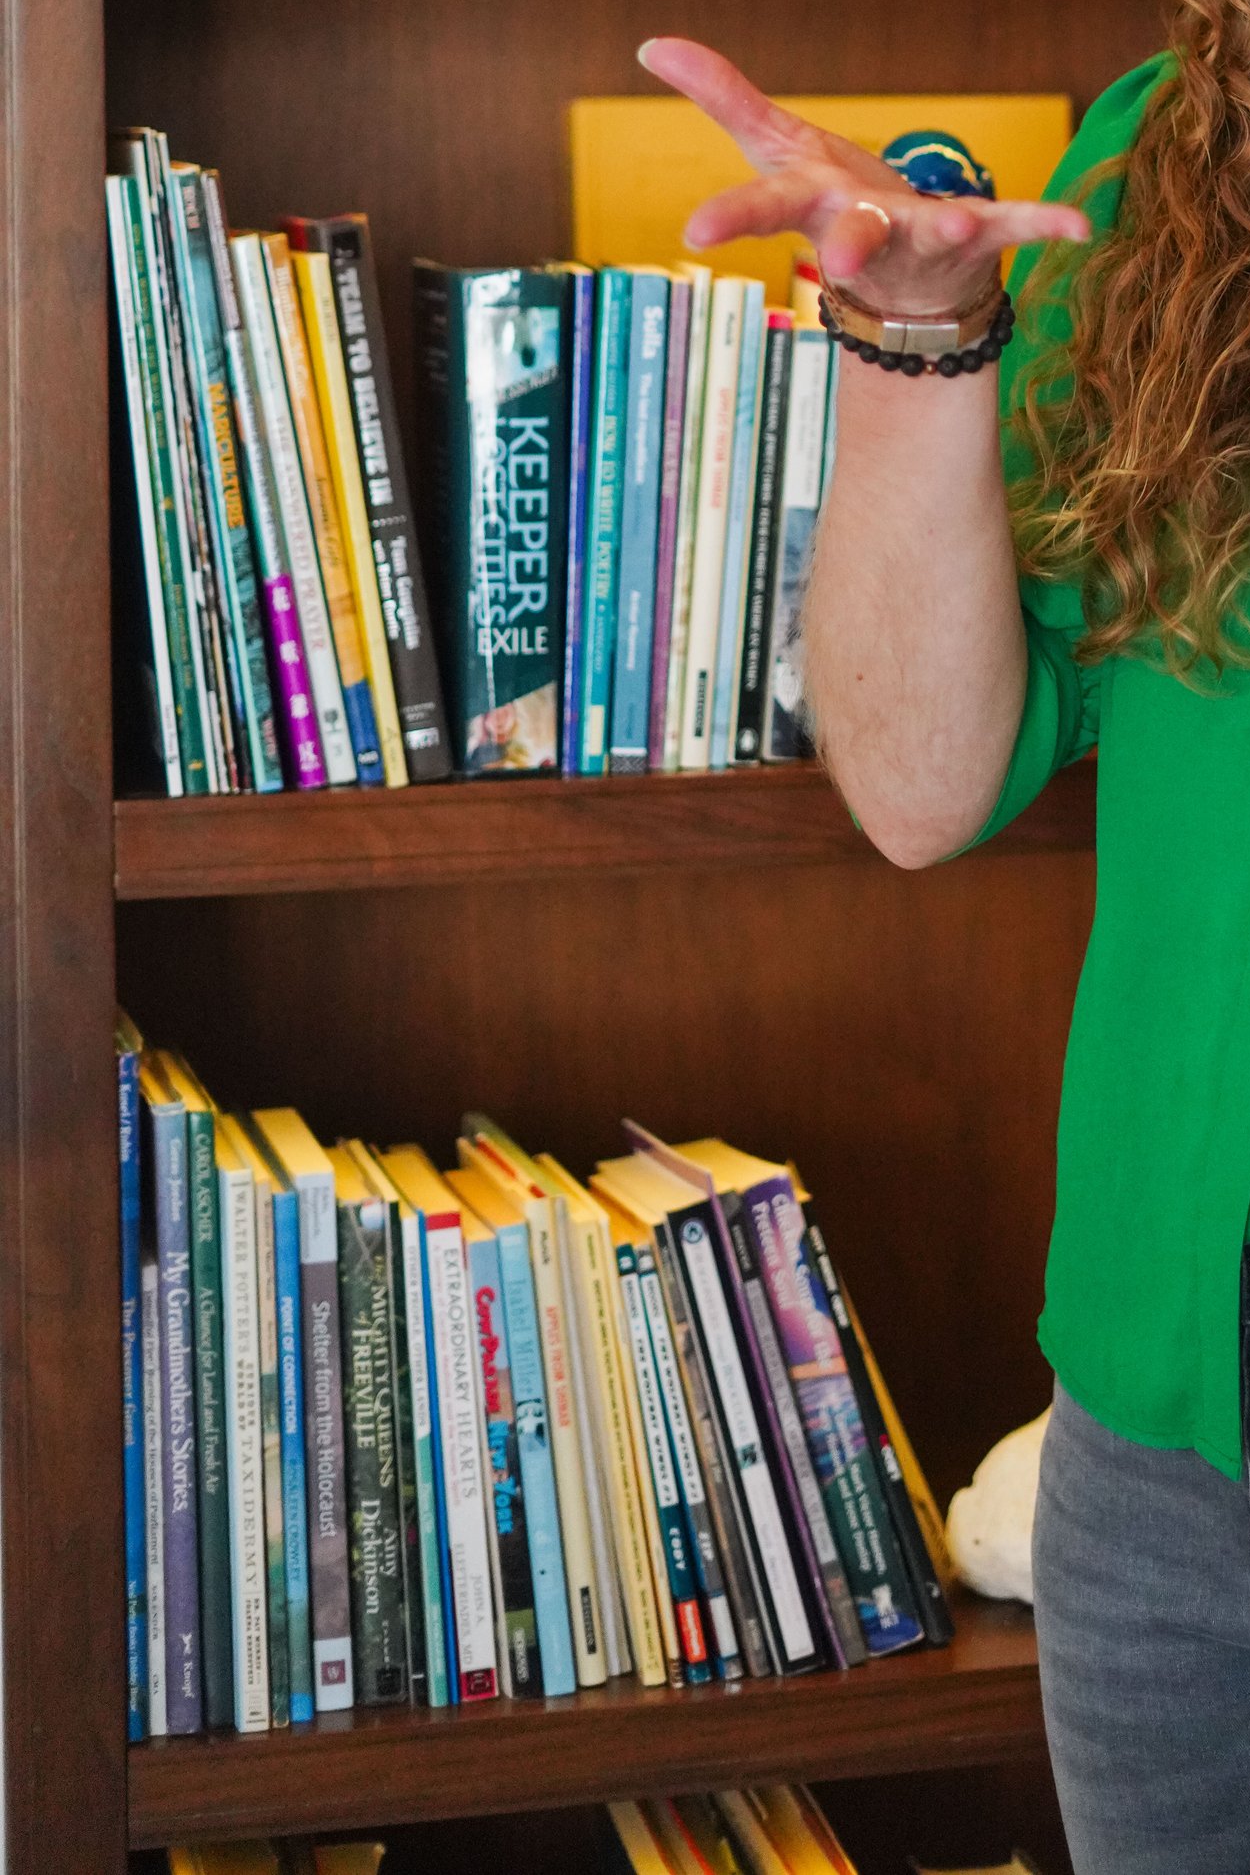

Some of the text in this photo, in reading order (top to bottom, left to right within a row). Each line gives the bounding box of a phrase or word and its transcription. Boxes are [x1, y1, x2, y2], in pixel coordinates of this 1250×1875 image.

[642, 305, 664, 360] Sulla
[336, 267, 395, 507] TEAM TO BELIEVE IN
[507, 416, 550, 623] KEEPER
[475, 514, 507, 626] CITIES
[476, 624, 549, 656] EXILE
[193, 1134, 214, 1243] CAROL ASCHER
[162, 1251, 190, 1283] My
[234, 1190, 253, 1355] WALTER POTTER'S
[407, 1245, 419, 1287] OTHER
[751, 1200, 798, 1311] Preteen Soul
[771, 1193, 803, 1263] Chicken
[793, 1263, 817, 1309] Soup
[121, 1296, 136, 1326] The
[198, 1298, 214, 1349] Chance
[166, 1287, 193, 1436] Grandmother's
[197, 1349, 215, 1369] for
[282, 1296, 298, 1434] POINT OF CONNECTION
[371, 1283, 395, 1488] MIGHTY QUEENS
[411, 1341, 425, 1384] OTHER
[443, 1247, 478, 1501] EXTRAORDINARY HEARTS
[200, 1372, 216, 1406] Land
[351, 1327, 376, 1449] FREEVILLE
[202, 1408, 217, 1431] and
[312, 1300, 337, 1539] Shelter from the Holocaust
[203, 1433, 220, 1473] Fresh
[205, 1473, 220, 1495] Air
[239, 1435, 258, 1586] TAXIDERMY
[359, 1497, 382, 1615] Dickinson
[380, 1527, 398, 1576] Amy
[470, 1573, 485, 1613] JOHN
[178, 1661, 193, 1699] Knopf
[460, 1644, 472, 1666] MD
